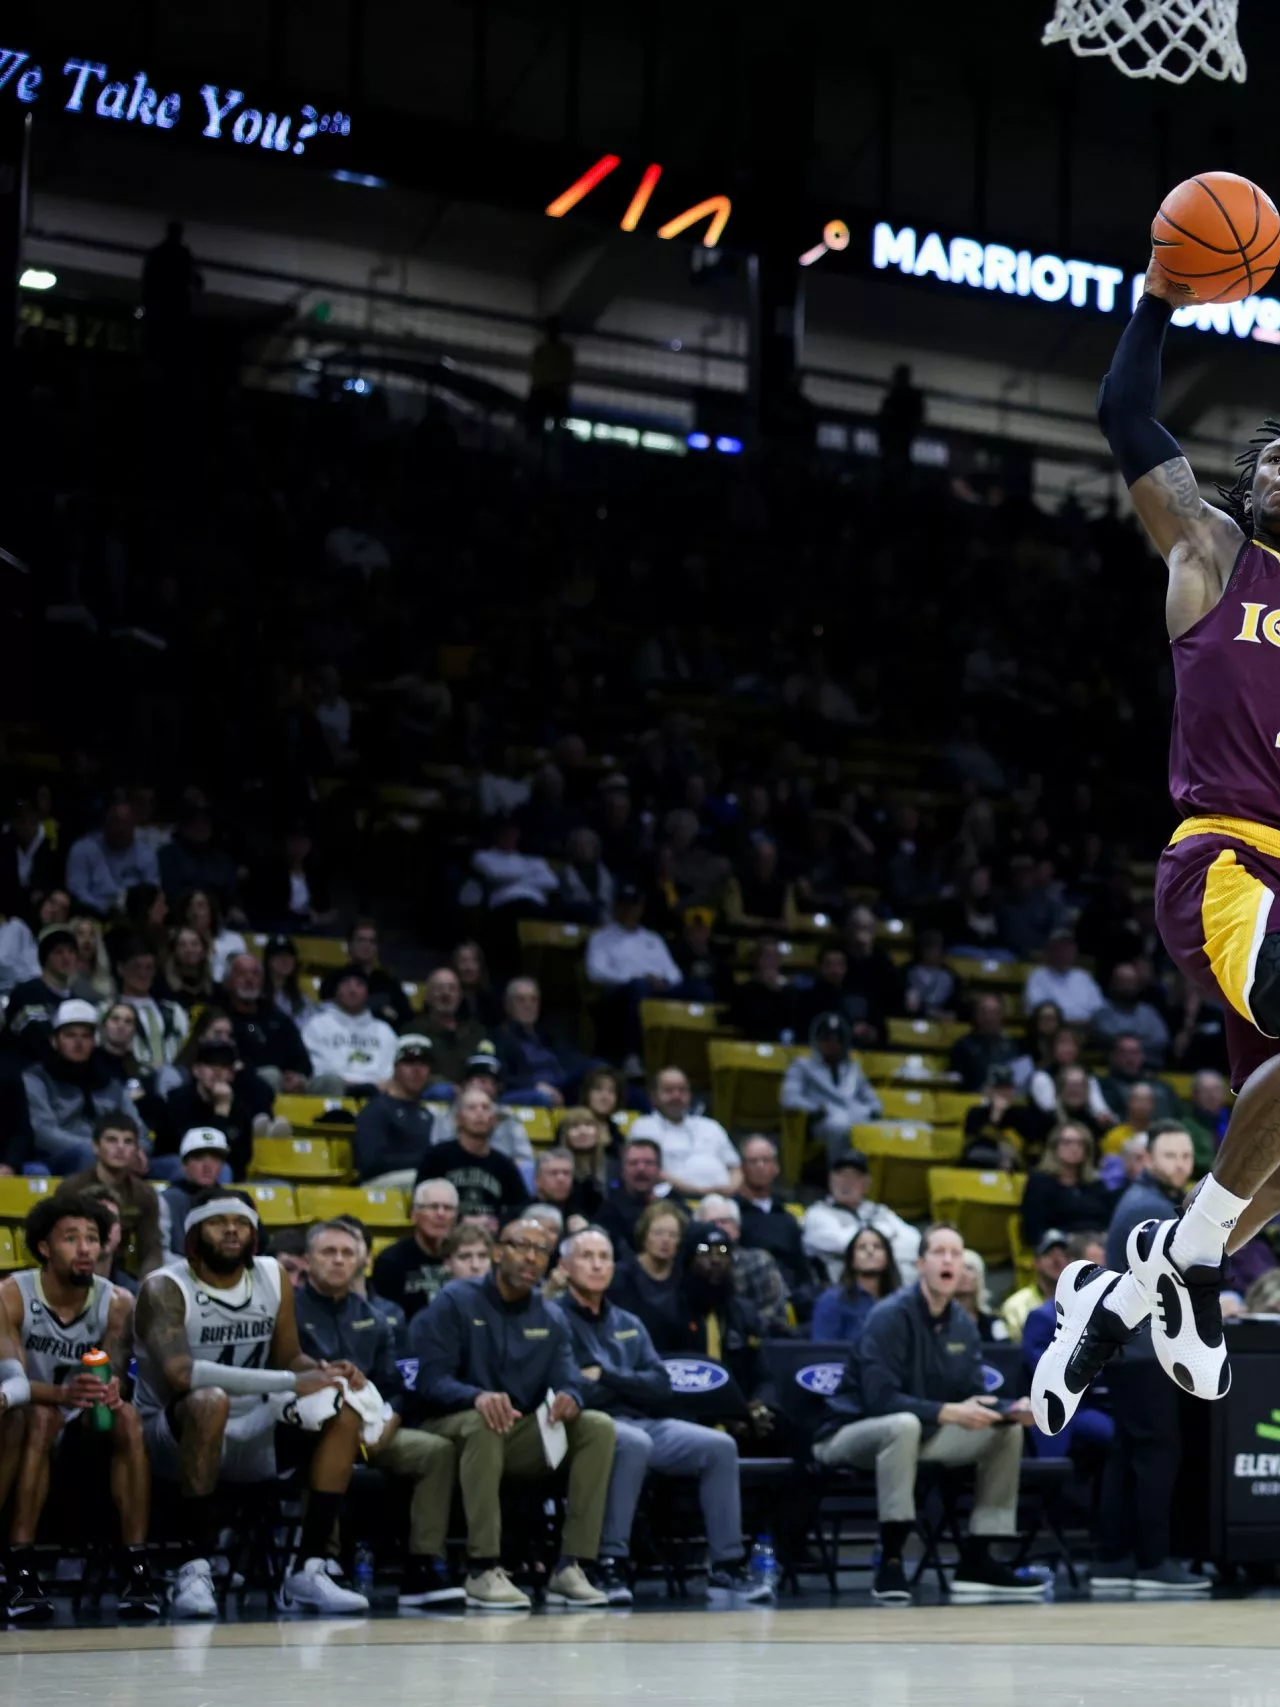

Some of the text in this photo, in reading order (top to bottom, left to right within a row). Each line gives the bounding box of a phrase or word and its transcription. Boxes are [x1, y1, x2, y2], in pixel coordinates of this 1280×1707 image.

[63, 58, 182, 129] Take
[873, 222, 1123, 313] MARRIOTT
[25, 1334, 103, 1360] BUFFALO
